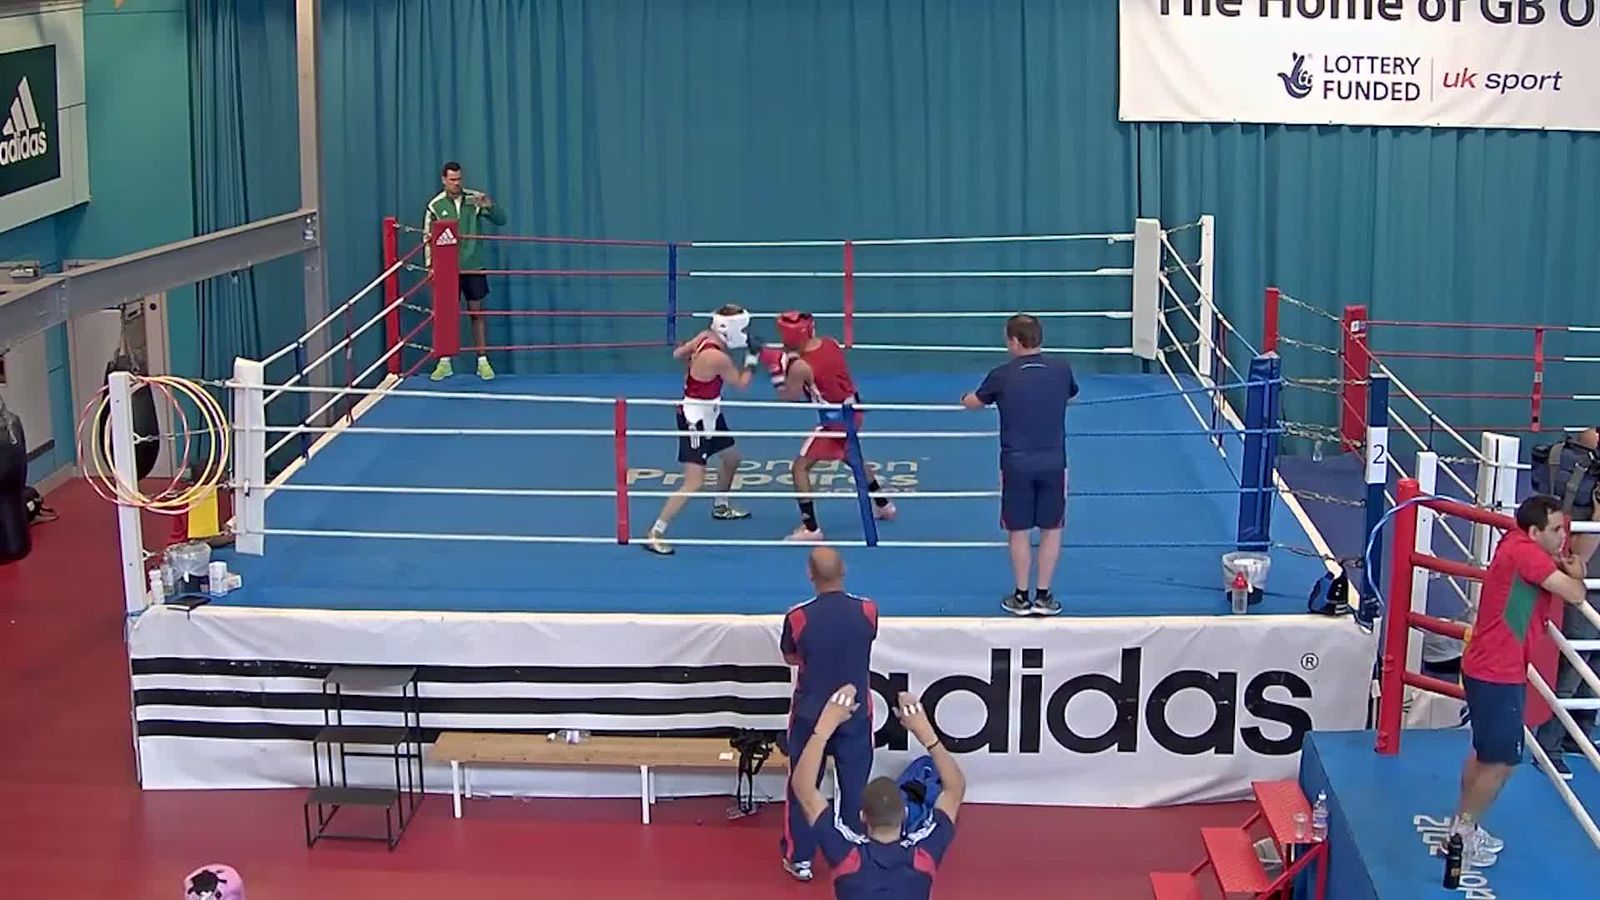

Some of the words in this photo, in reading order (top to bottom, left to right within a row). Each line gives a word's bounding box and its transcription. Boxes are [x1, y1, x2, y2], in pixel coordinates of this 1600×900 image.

[1480, 0, 1546, 24] GB
[1323, 54, 1421, 75] LOTTERY
[1323, 80, 1421, 102] FUNDED
[1442, 67, 1479, 89] uk
[1484, 71, 1563, 95] sport
[0, 127, 48, 165] adidas
[1372, 443, 1385, 465] 2
